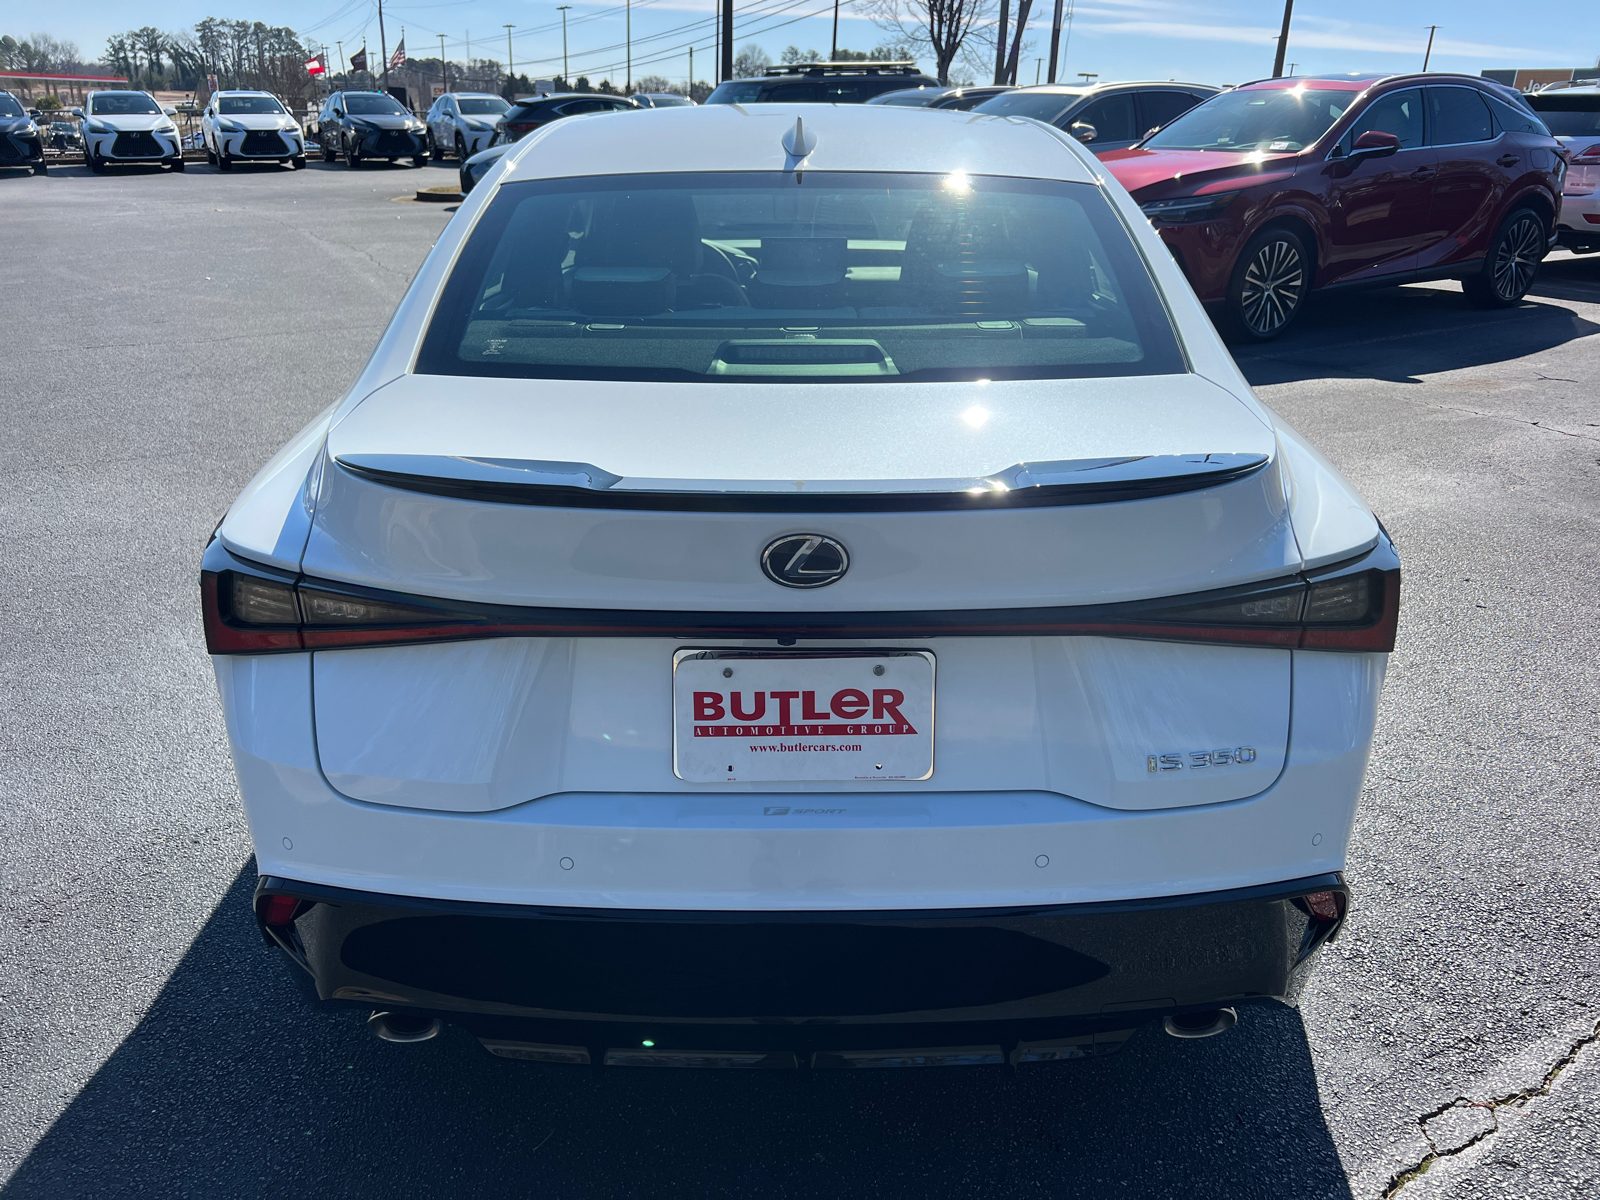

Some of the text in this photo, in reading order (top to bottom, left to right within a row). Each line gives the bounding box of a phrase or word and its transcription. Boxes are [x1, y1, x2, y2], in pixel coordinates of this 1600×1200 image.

[695, 724, 909, 736] AUTOMOTIVE GROUP
[749, 742, 862, 753] www.butlercars.com
[1147, 745, 1257, 773] IS 350
